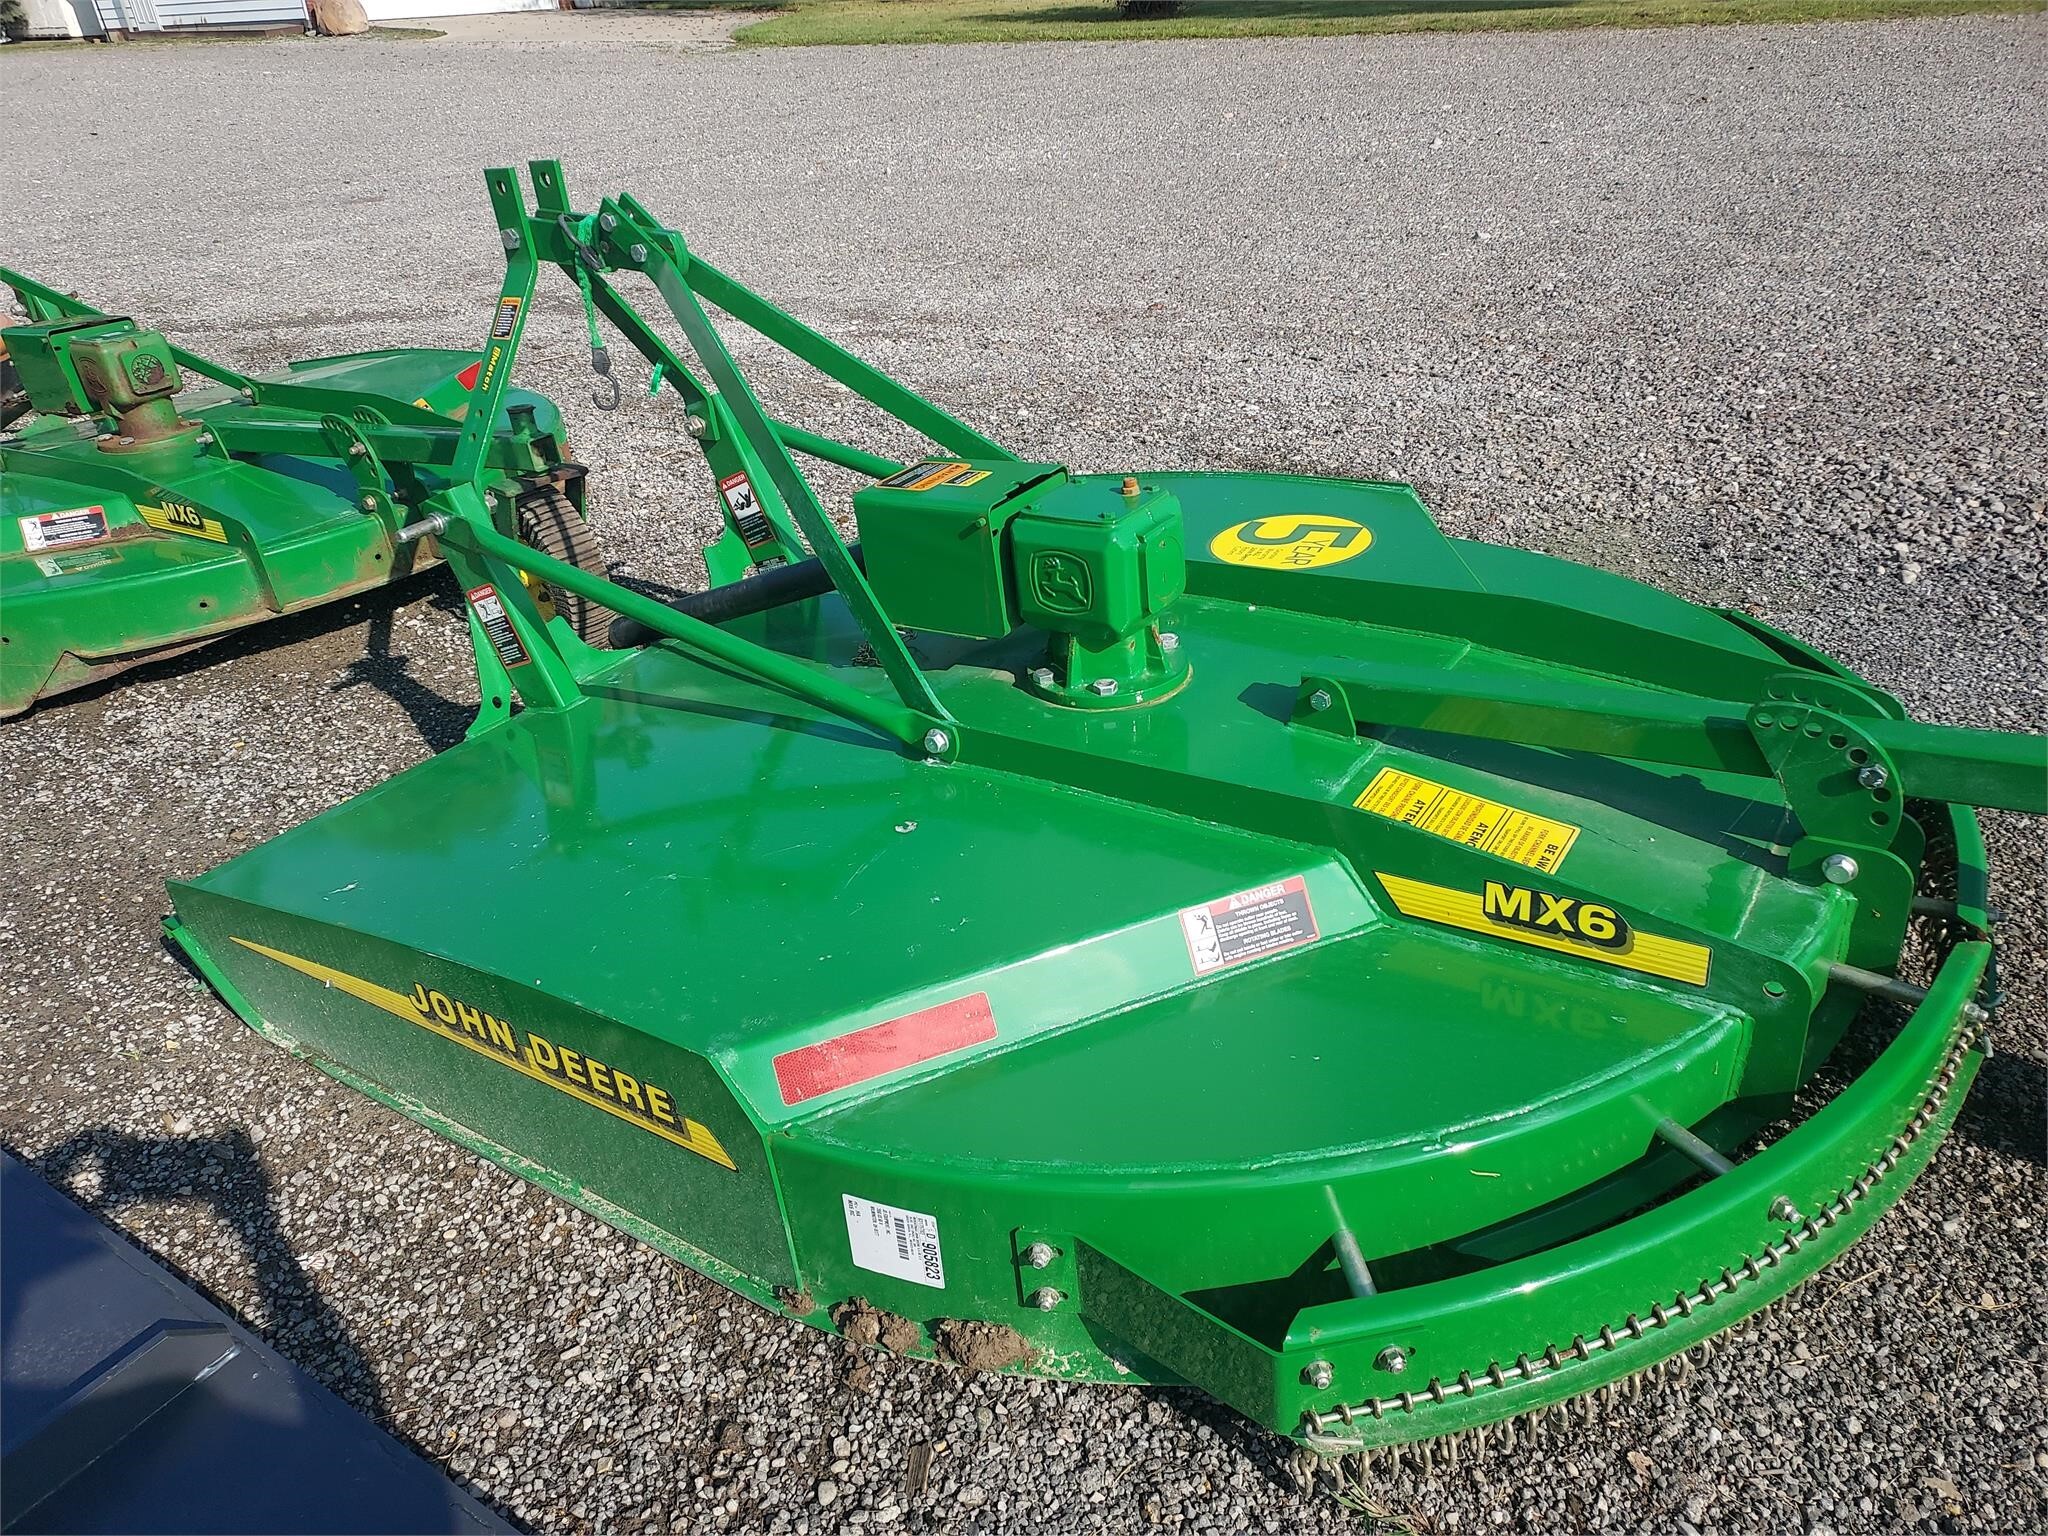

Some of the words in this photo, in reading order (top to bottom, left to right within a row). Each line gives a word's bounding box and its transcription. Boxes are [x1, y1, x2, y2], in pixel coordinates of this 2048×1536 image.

[726, 474, 745, 486] DANGER
[162, 501, 200, 525] MX6
[1237, 521, 1363, 548] 5
[1281, 539, 1330, 566] YEAR
[1543, 843, 1558, 855] BE
[1240, 884, 1286, 905] DANGER
[1485, 882, 1616, 940] MX6
[408, 982, 518, 1053] JOHN
[527, 1032, 679, 1125] DEERE
[921, 1241, 940, 1280] 905823
